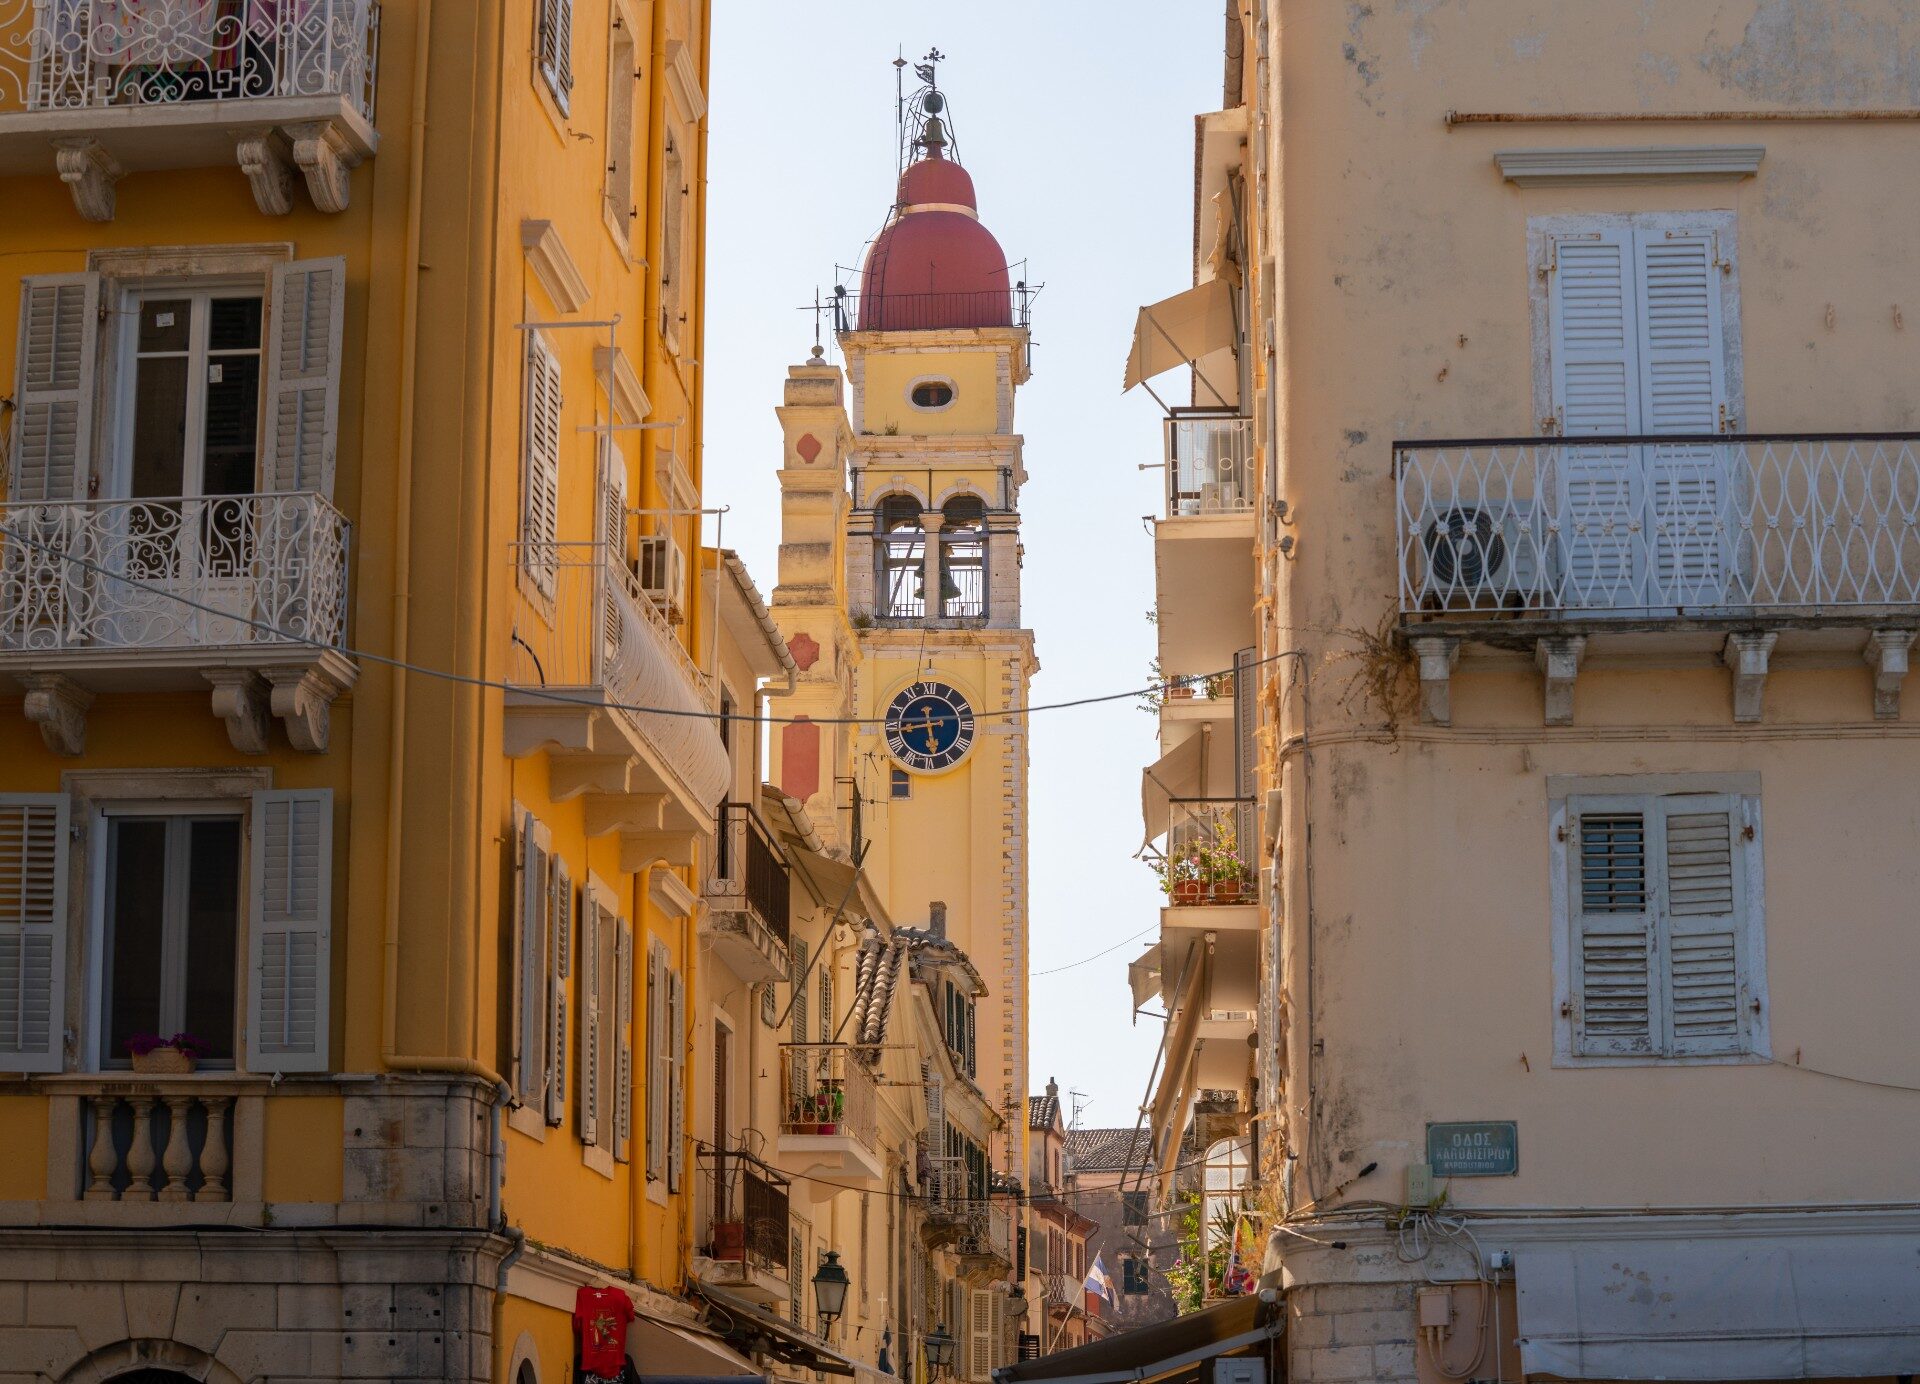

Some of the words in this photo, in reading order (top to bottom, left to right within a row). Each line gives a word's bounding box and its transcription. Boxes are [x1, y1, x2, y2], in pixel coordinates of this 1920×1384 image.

[904, 687, 917, 701] XI
[924, 683, 936, 694] XII
[945, 689, 953, 699] I
[891, 702, 903, 712] X
[956, 702, 969, 712] II
[962, 721, 973, 730] III
[889, 736, 903, 753] VIII
[955, 737, 970, 752] IIII
[903, 751, 915, 765] VII
[925, 758, 934, 769] VI
[946, 754, 954, 765] V
[1453, 1132, 1492, 1147] ΟΔΟΣ
